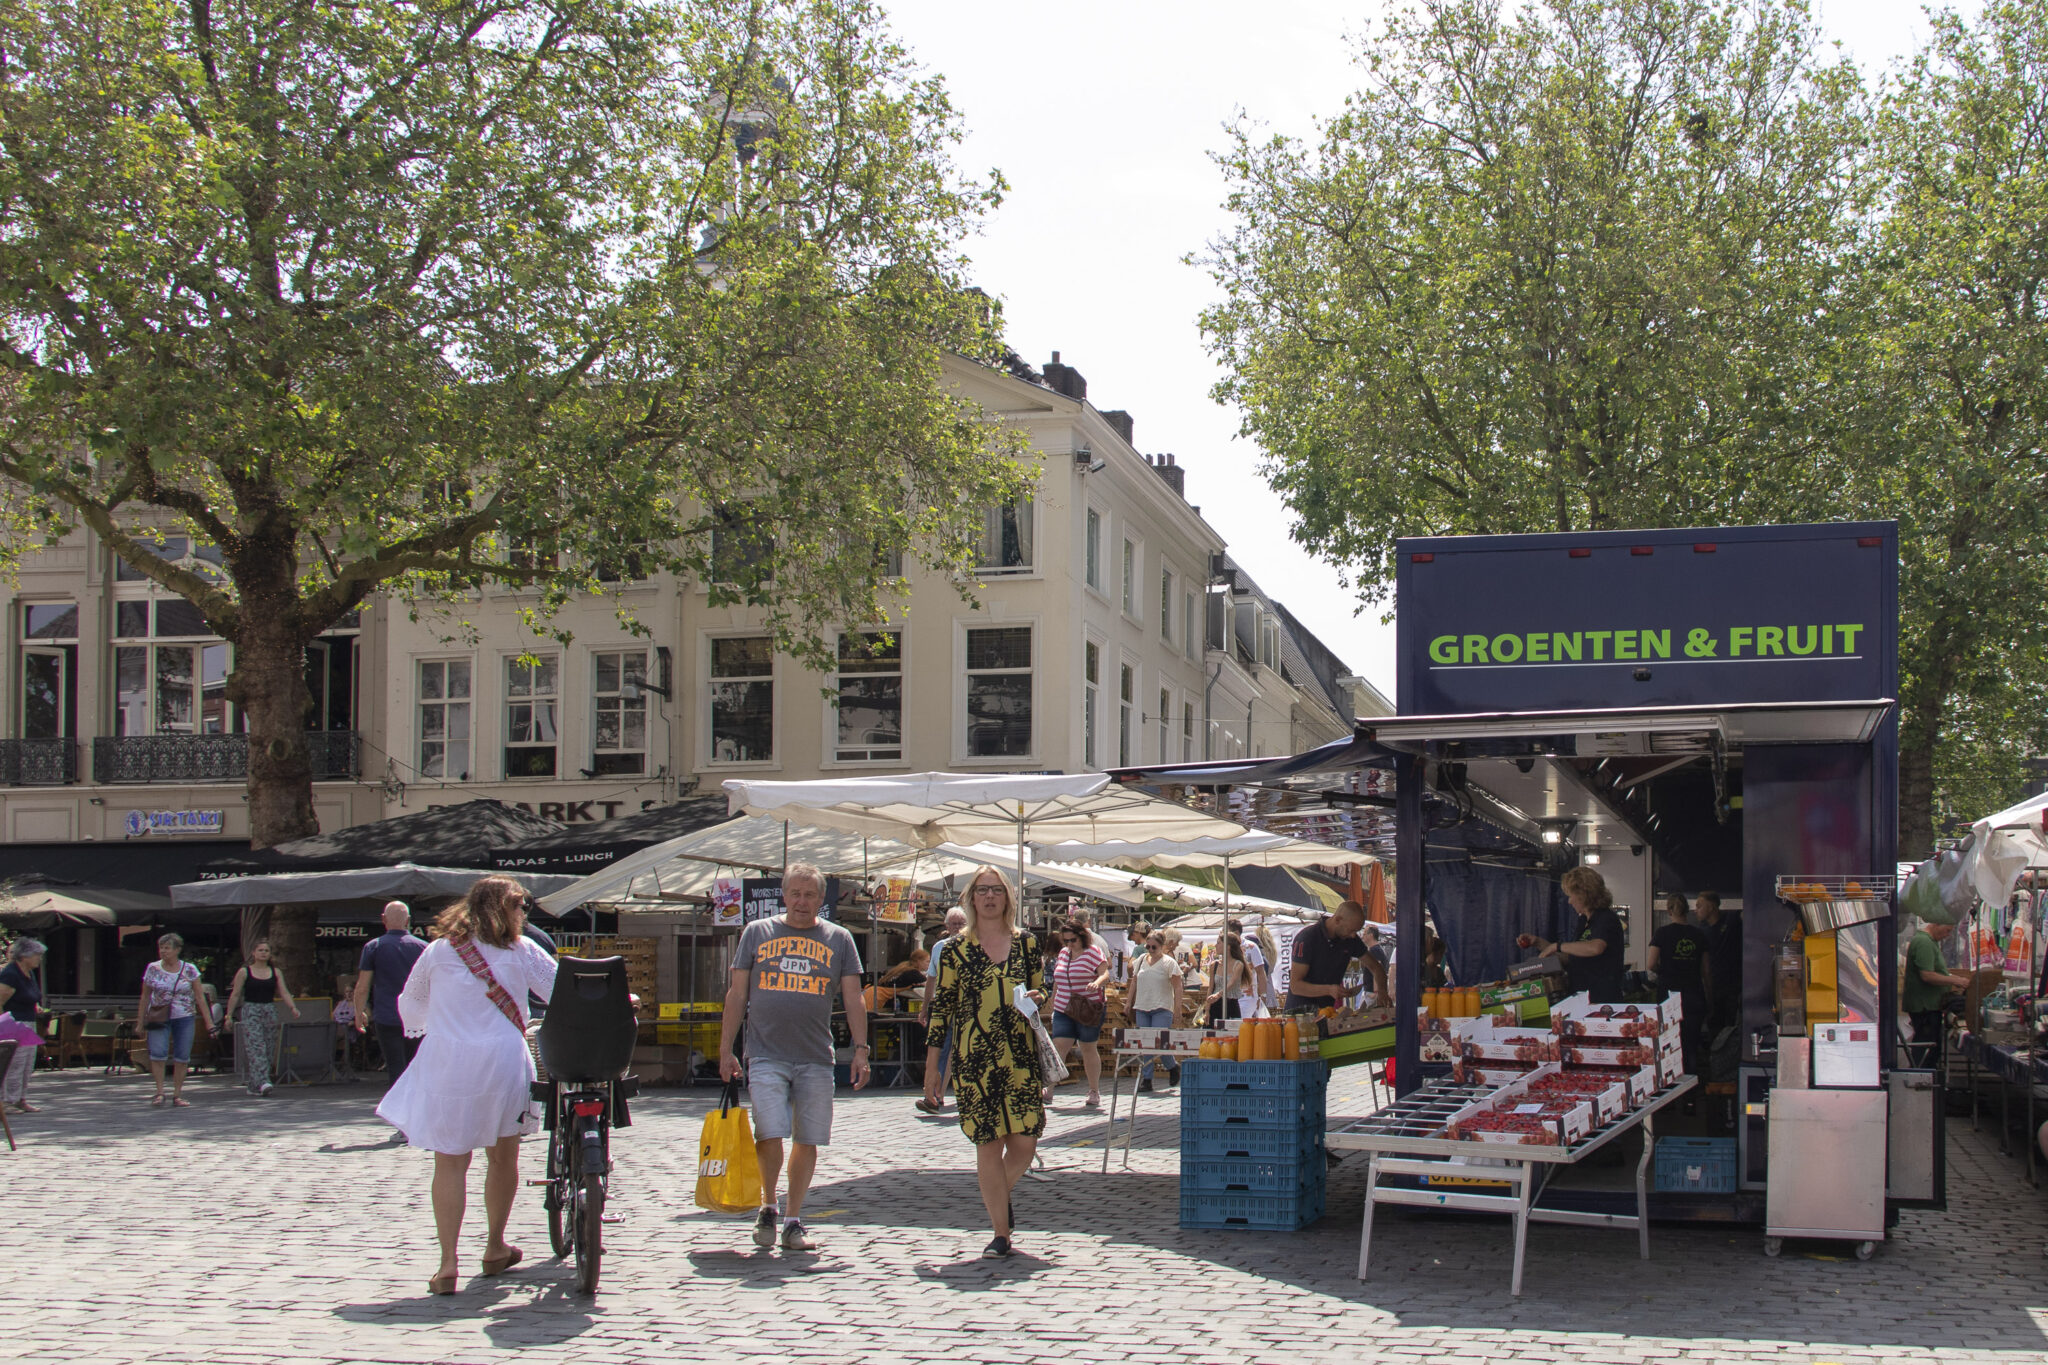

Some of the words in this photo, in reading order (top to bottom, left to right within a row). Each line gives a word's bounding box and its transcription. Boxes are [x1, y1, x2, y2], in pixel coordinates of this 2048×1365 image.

[1428, 629, 1671, 664] GROENTEN
[1684, 628, 1717, 657] &
[1730, 624, 1864, 656] FRUIT
[496, 857, 547, 867] TAPAS
[565, 851, 614, 863] LUNCH
[315, 926, 369, 937] ORREL
[757, 936, 834, 969] SUPERDRY
[783, 960, 807, 972] JPN
[758, 970, 831, 996] ACADEMY
